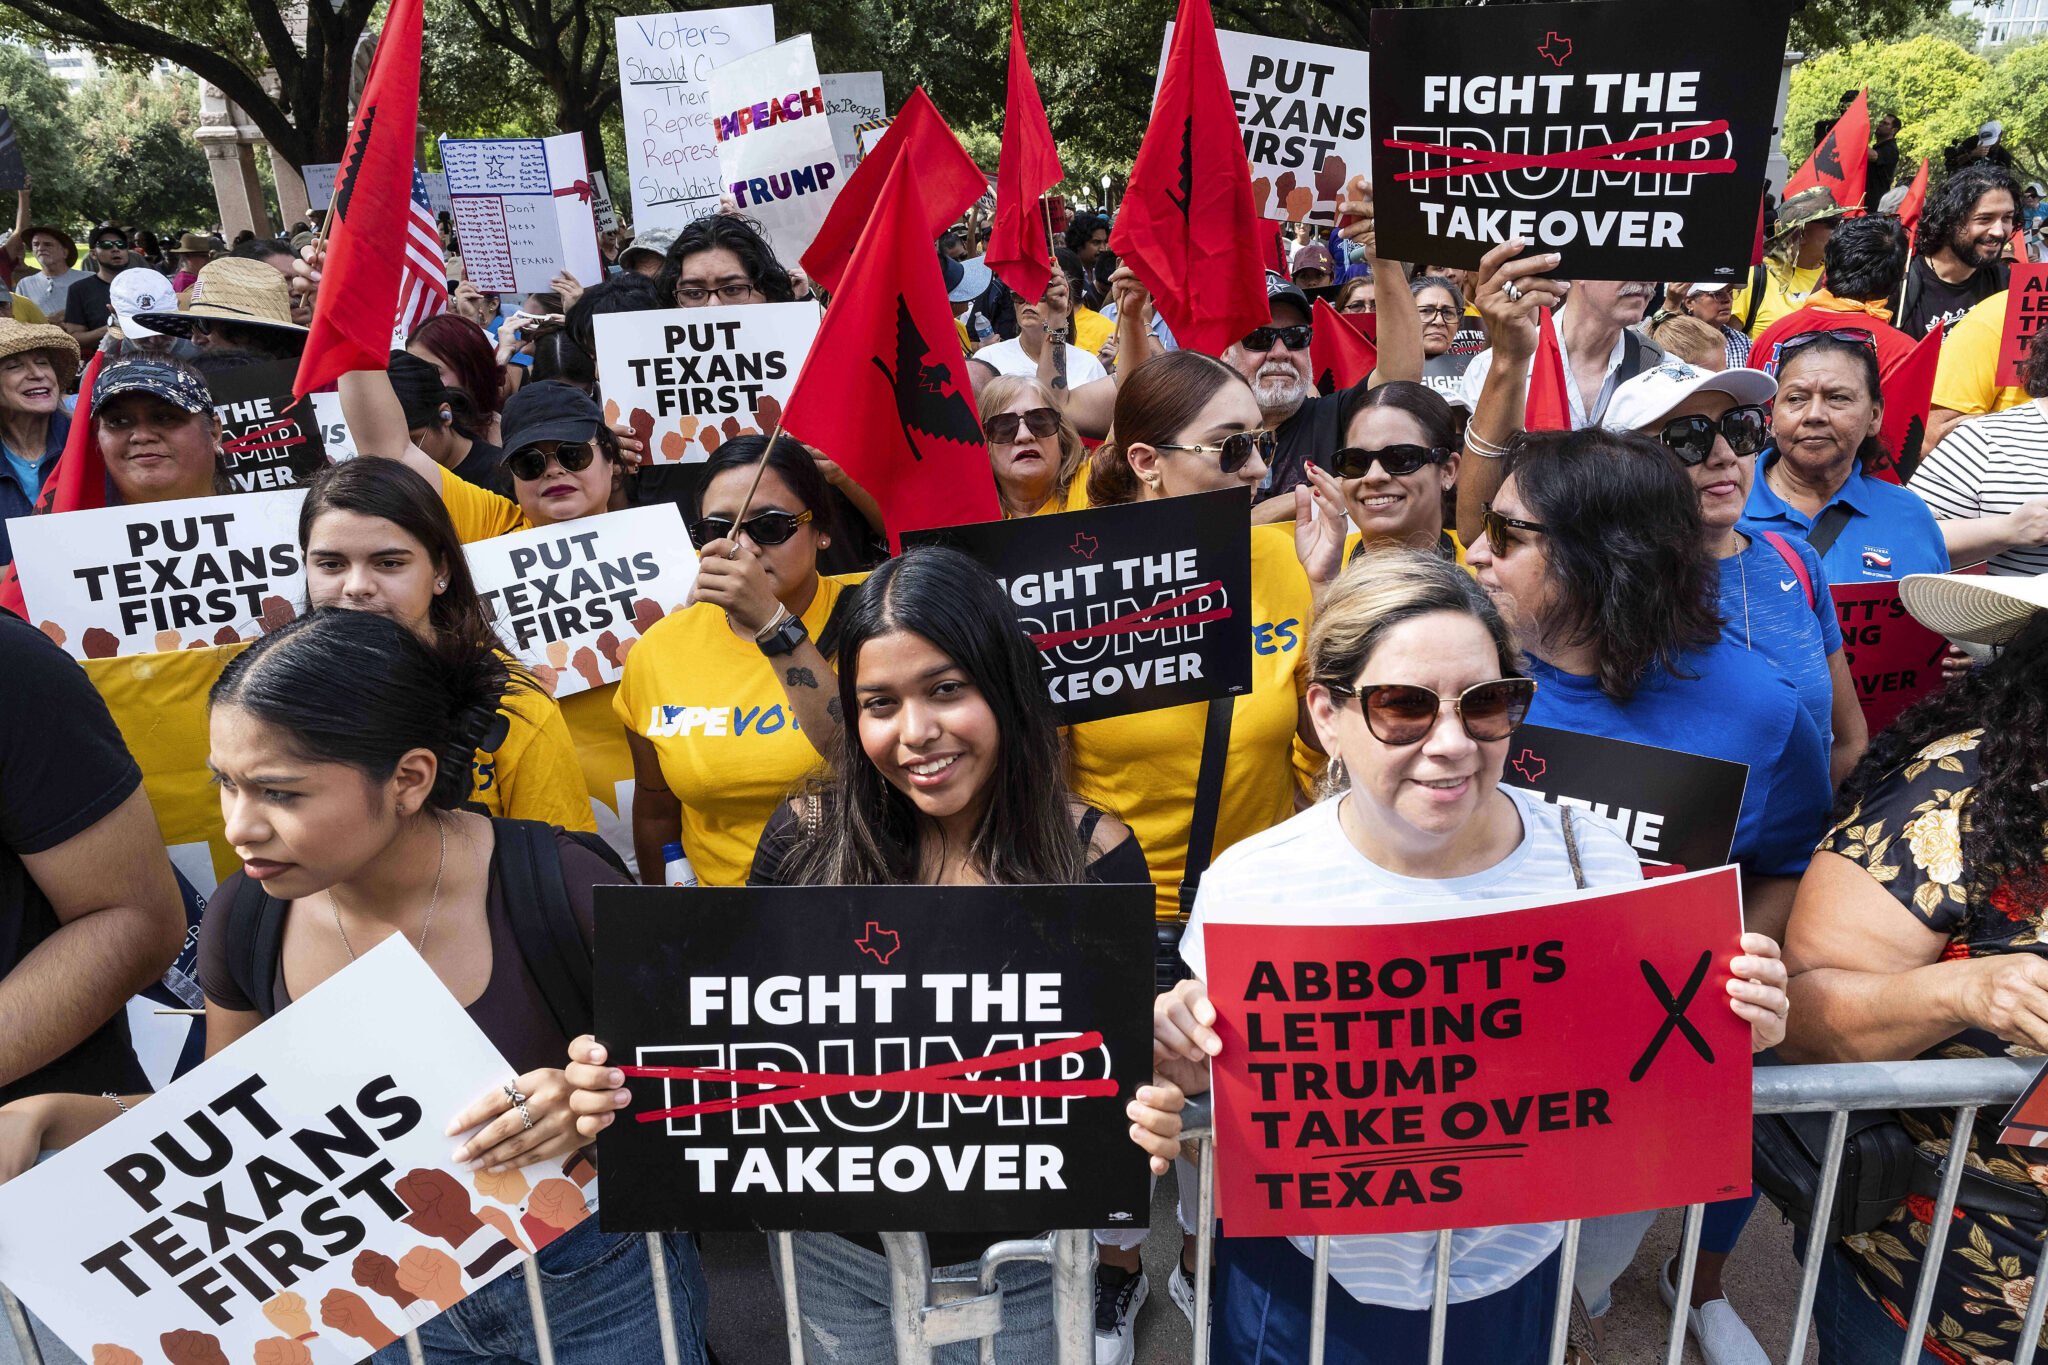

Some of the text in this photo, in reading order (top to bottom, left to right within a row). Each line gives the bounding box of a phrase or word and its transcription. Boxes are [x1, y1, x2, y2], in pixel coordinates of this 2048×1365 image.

[637, 17, 730, 50] Voters
[626, 54, 687, 82] Should
[1247, 55, 1334, 98] PUT
[656, 86, 709, 106] Their
[713, 87, 824, 143] IMPEACH
[1229, 90, 1366, 140] EXANS
[1424, 72, 1701, 114] FIGHT THE
[1241, 129, 1336, 172] IRST
[1393, 121, 1732, 199] TRUMP
[505, 203, 535, 212] Don't
[639, 175, 715, 203] Shouldn't
[730, 162, 835, 209] TRUMP
[1419, 202, 1683, 248] TAKEOVER
[513, 257, 554, 265] TEXANS
[664, 321, 741, 353] PUT
[628, 351, 787, 386] TEXANS
[213, 398, 274, 425] THE
[656, 384, 763, 417] FIRST
[126, 513, 235, 557] PUT
[509, 531, 598, 579] PUT
[73, 544, 299, 601] TEXANS
[477, 552, 660, 622] TEXANS
[1113, 549, 1197, 590] THE
[119, 583, 269, 635] FIRST
[512, 588, 638, 650] FIRST
[1017, 582, 1228, 670] RUMP
[1048, 653, 1204, 703] KEOVER
[647, 705, 730, 737] LUPE
[1244, 940, 1566, 1003] ABBOTT'S
[689, 973, 1062, 1026] FIGHT THE
[1246, 999, 1522, 1052] LETTING
[635, 1032, 1111, 1136] TRUMP
[1249, 1053, 1478, 1101] TRUMP
[1252, 1087, 1612, 1148] TAKE OVER
[103, 1073, 283, 1213] PUT
[81, 1074, 422, 1298] TEXANS
[685, 1144, 1067, 1193] TAKEOVER
[1255, 1165, 1463, 1209] TEXAS
[178, 1158, 413, 1326] FIRST
